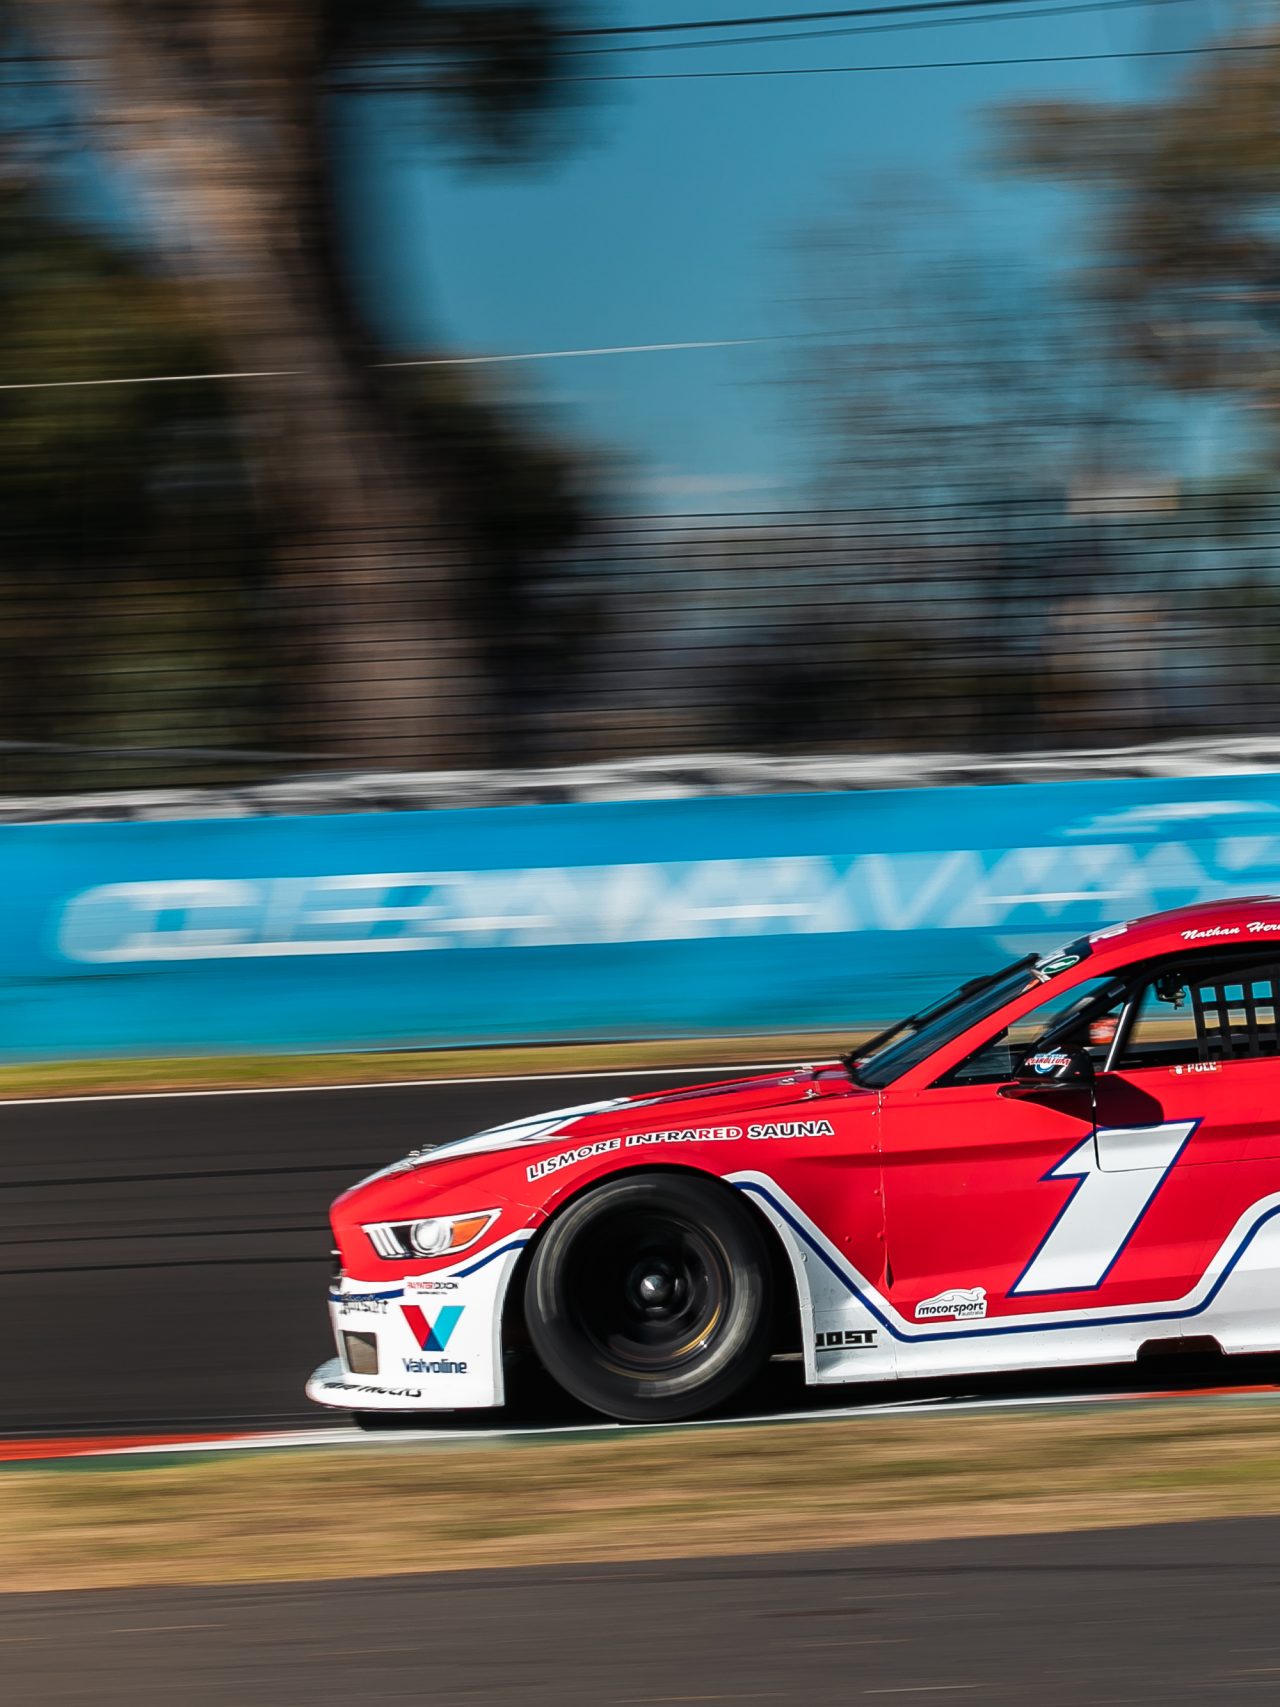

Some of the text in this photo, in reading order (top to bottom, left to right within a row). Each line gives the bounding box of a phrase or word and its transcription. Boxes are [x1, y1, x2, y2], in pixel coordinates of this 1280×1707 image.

[1180, 926, 1241, 940] Nathan
[527, 1120, 834, 1182] LISMORE INFRARED SAUNA
[1004, 1116, 1206, 1299] 1
[918, 1302, 985, 1316] motorsport
[815, 1329, 878, 1347] JOST
[402, 1358, 467, 1373] Valvoline
